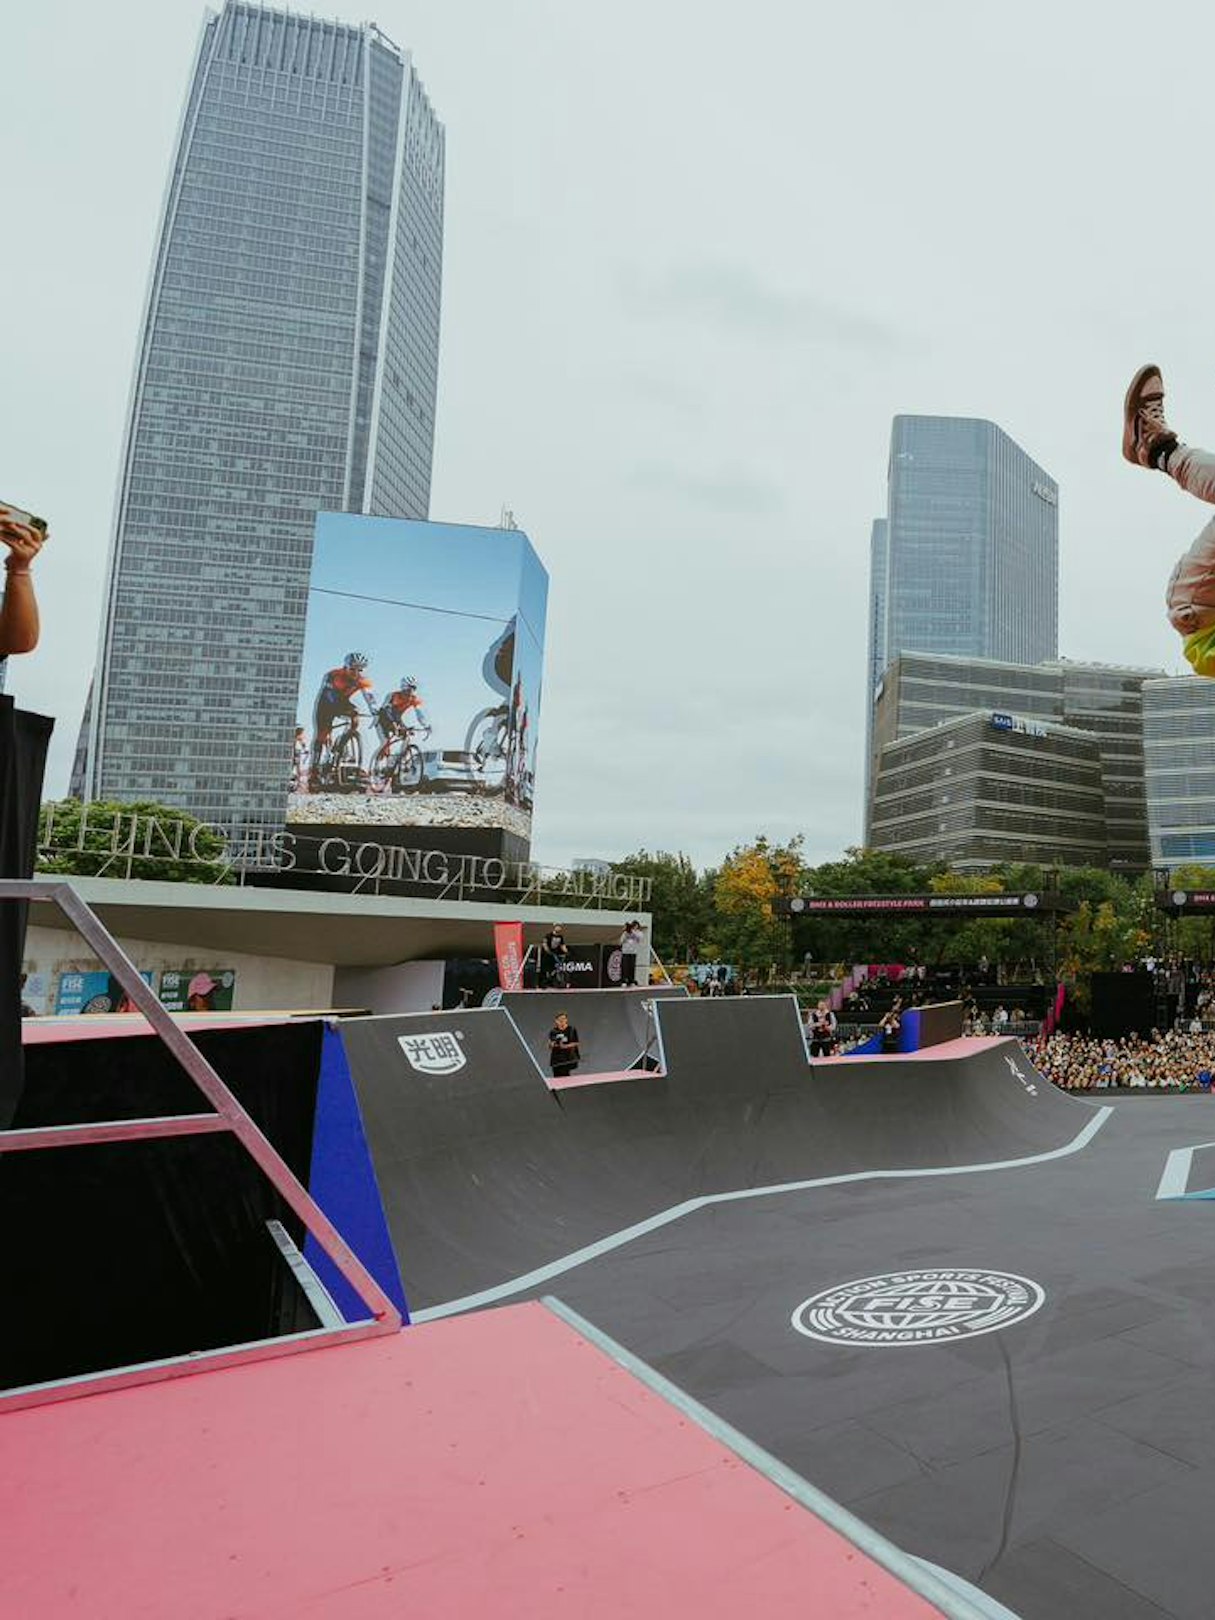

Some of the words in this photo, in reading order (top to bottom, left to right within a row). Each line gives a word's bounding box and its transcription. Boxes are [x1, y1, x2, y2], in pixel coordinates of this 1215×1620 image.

[318, 838, 449, 884] GOING
[463, 855, 506, 889] TO
[404, 1035, 460, 1062] 光明
[817, 1280, 888, 1307] ACTION
[891, 1272, 982, 1284] SPORTS
[863, 1295, 979, 1312] FISE
[831, 1325, 962, 1341] SHANGHAI
